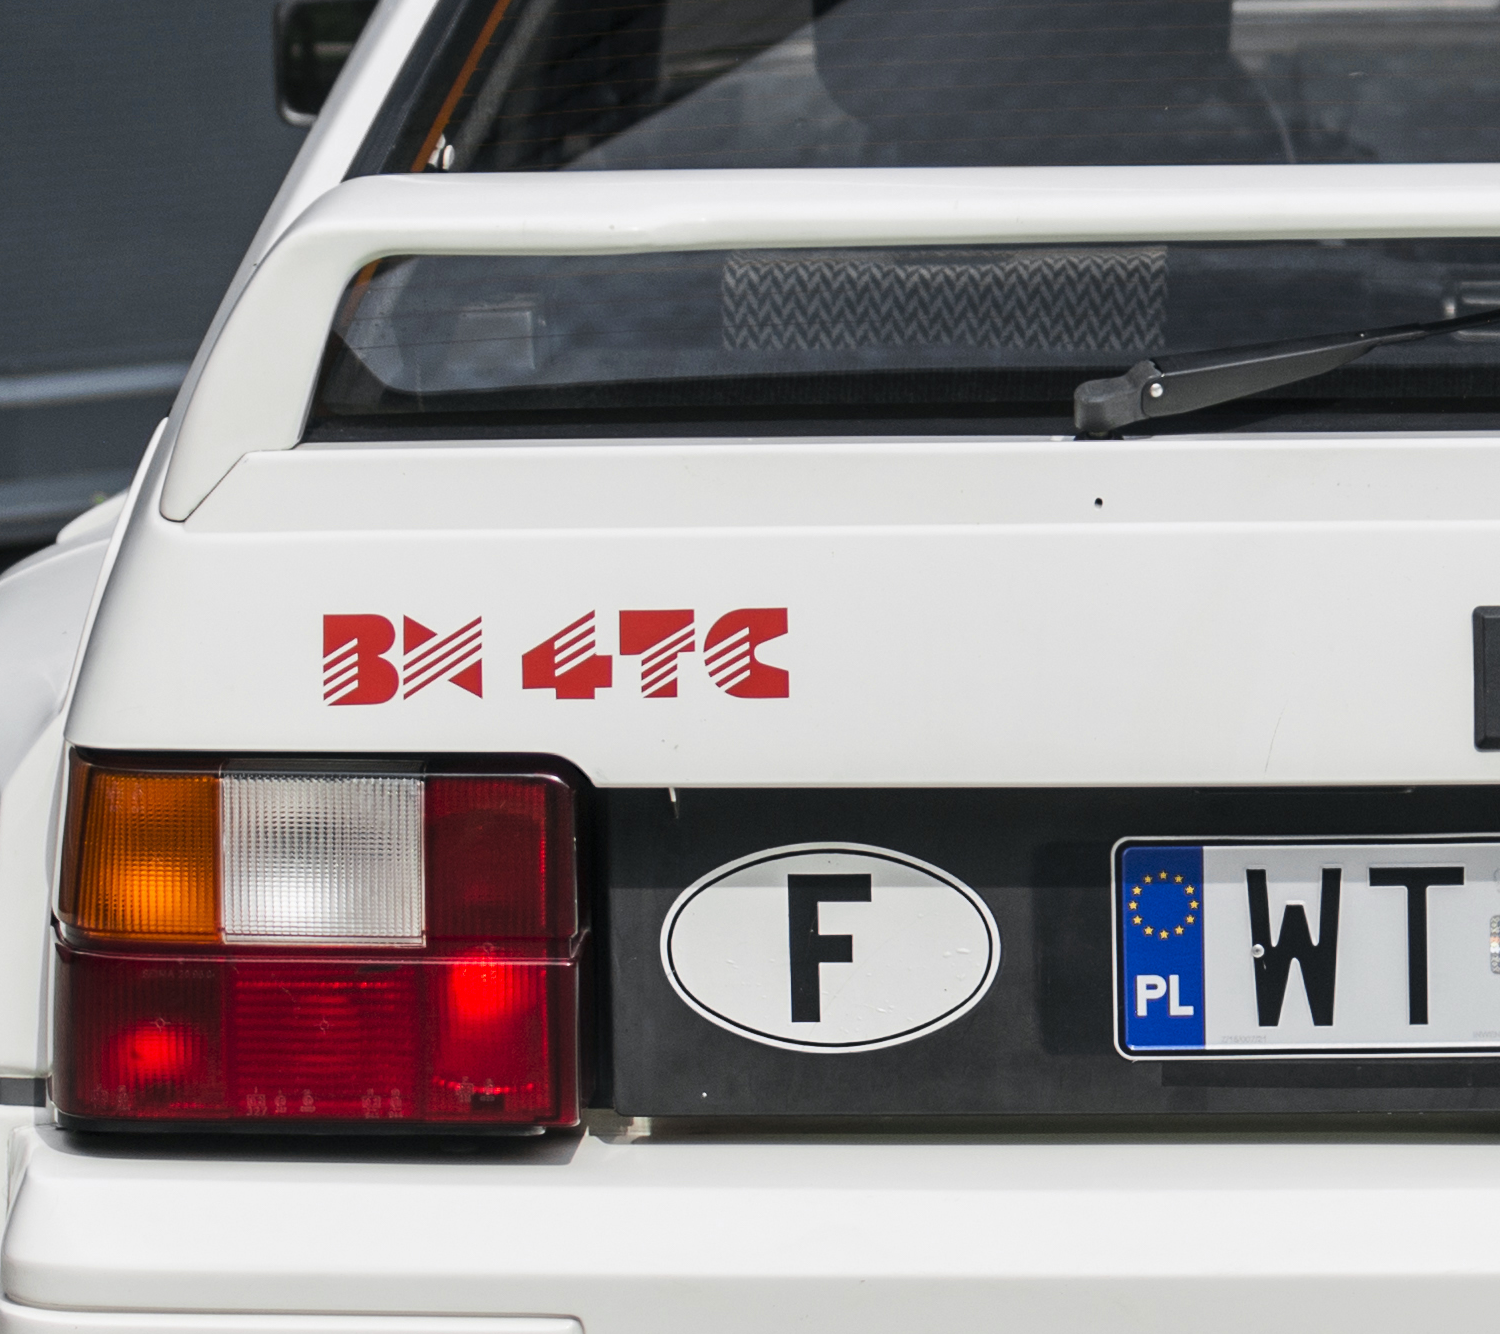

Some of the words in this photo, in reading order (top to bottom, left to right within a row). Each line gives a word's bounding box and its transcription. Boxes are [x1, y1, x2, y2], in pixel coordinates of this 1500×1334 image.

[323, 613, 483, 706] BX
[522, 607, 790, 700] 4TC
[787, 873, 872, 1023] F
[1137, 975, 1194, 1016] PL
[1245, 866, 1465, 1027] WT
